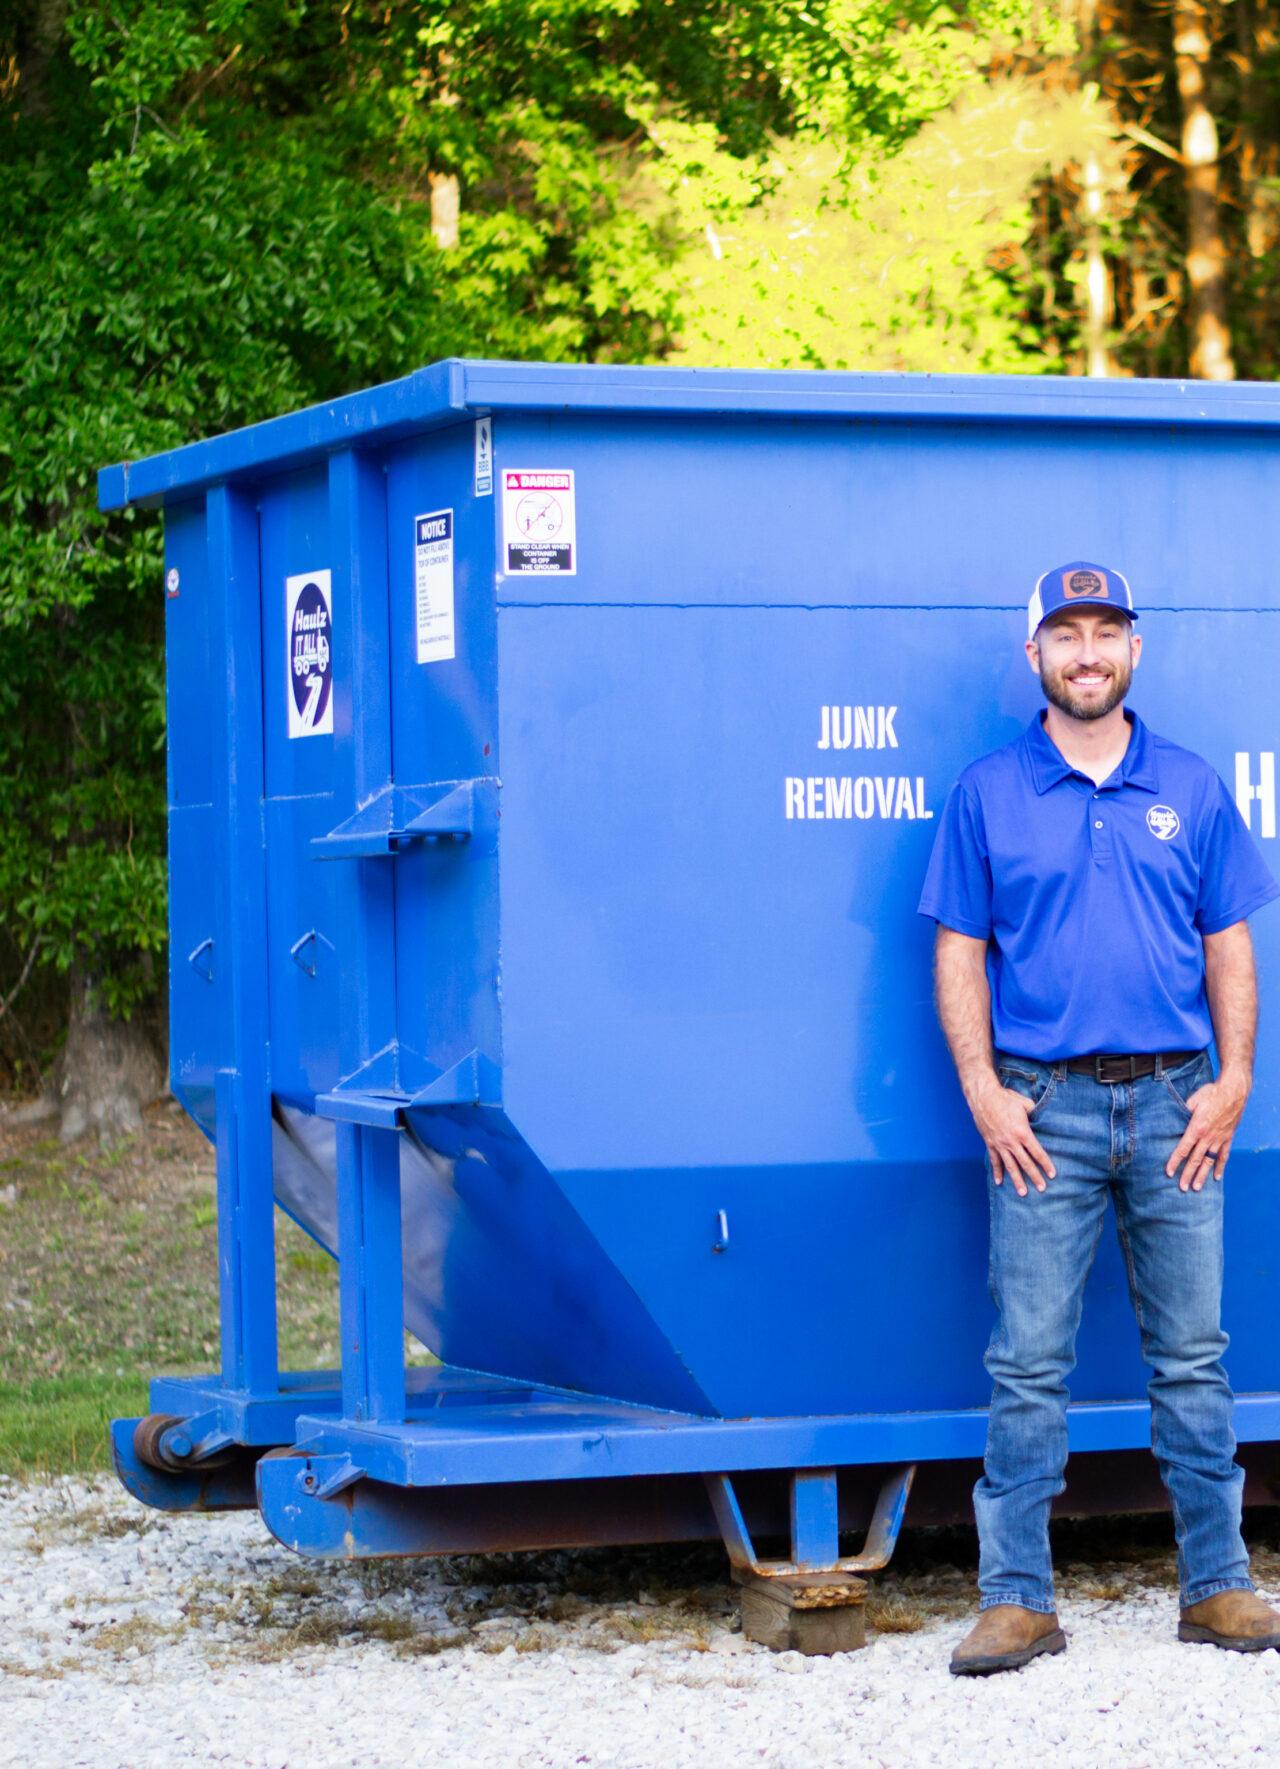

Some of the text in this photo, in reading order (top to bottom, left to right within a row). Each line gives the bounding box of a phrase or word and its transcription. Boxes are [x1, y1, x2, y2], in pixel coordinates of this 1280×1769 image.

[521, 475, 569, 488] DANGER
[421, 518, 447, 541] NOTICE
[295, 605, 327, 632] Haulz
[295, 633, 316, 656] IT ALL
[817, 705, 899, 750] JUNK
[785, 776, 934, 820] REMOVAL
